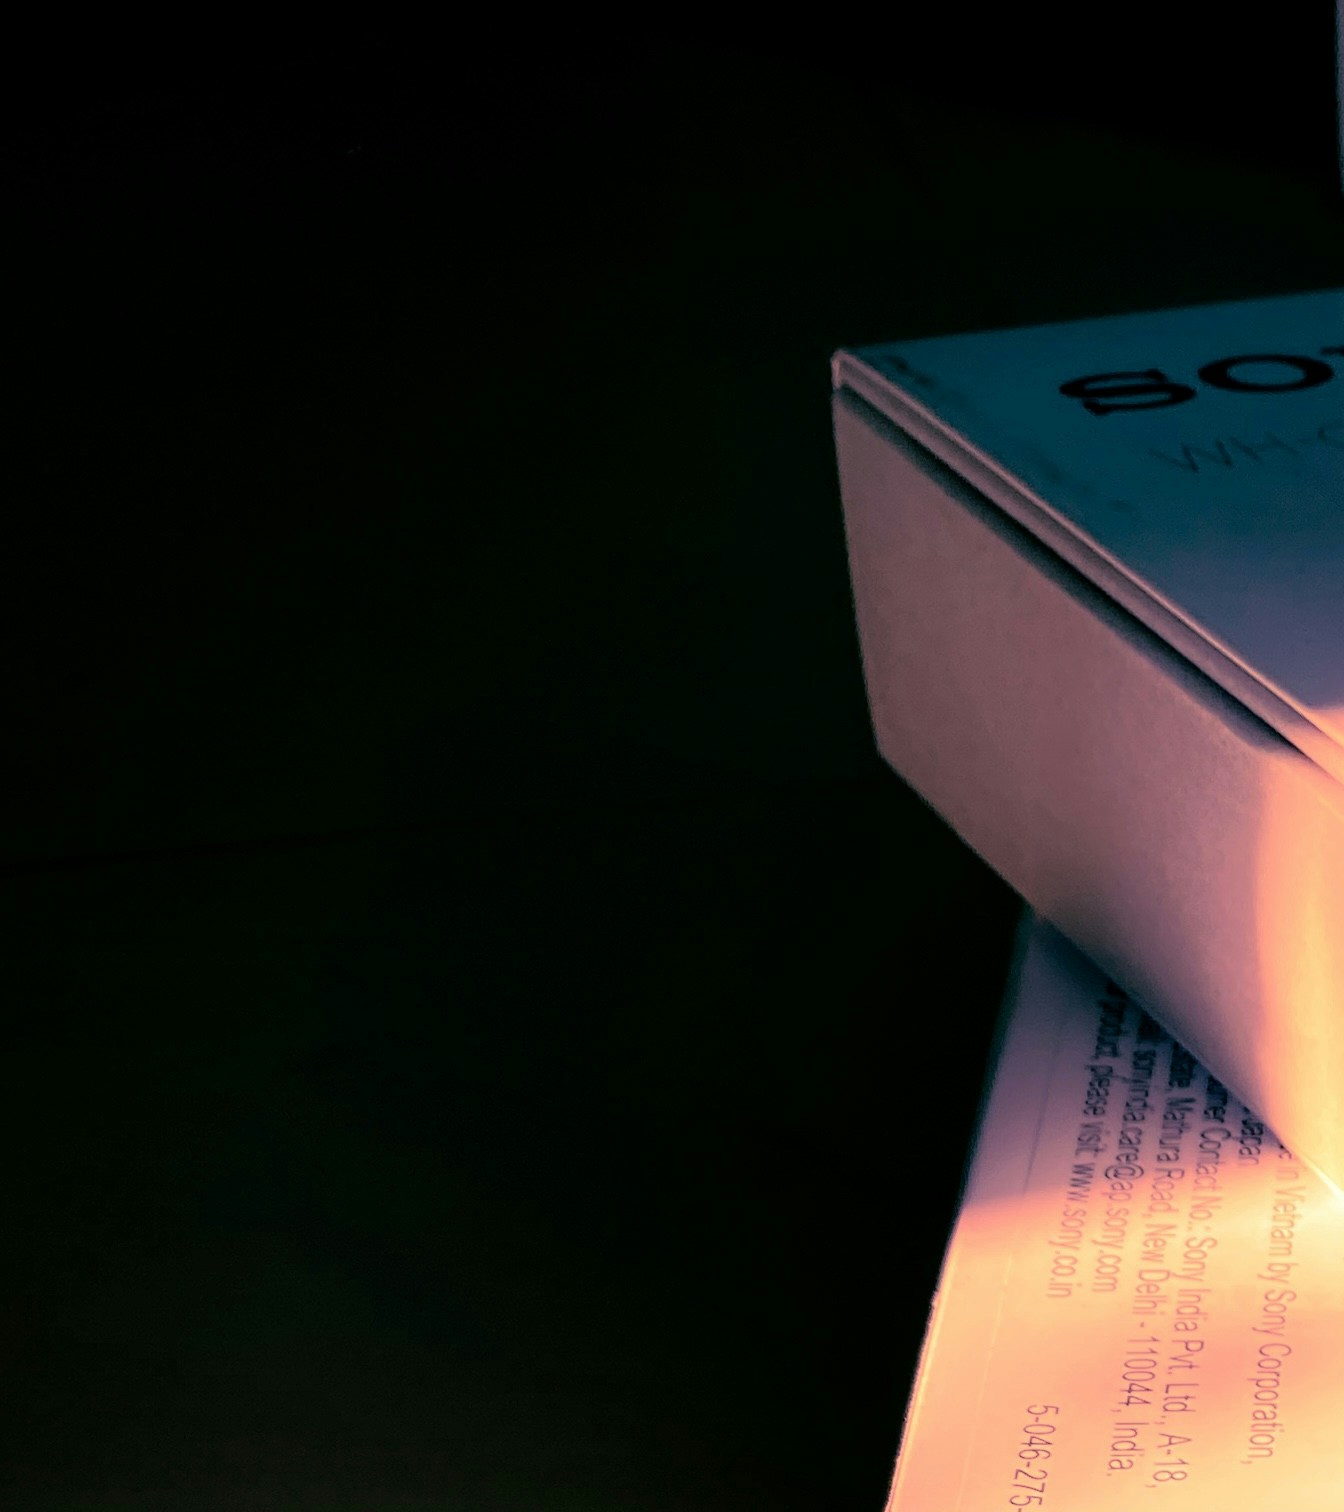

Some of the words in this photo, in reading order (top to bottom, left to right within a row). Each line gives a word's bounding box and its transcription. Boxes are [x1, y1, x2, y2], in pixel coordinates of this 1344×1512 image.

[1085, 1064, 1118, 1116] please
[1158, 1097, 1197, 1161] Mathura
[1092, 1049, 1158, 1292] sonyindia.care@ap.sony.com
[1196, 1128, 1232, 1191] Contact
[1143, 1168, 1185, 1218] Road,
[1046, 1163, 1097, 1298] www.sony.co.in
[1142, 1223, 1178, 1261] New
[1269, 1185, 1305, 1256] Vietnam
[1171, 1237, 1218, 1282] Sony
[1257, 1262, 1299, 1284] by
[1132, 1270, 1171, 1315] Delhi
[1174, 1289, 1214, 1332] India
[1251, 1289, 1297, 1337] Sony
[1111, 1335, 1161, 1413] 110044,
[1167, 1340, 1205, 1375] Pvt.
[1155, 1383, 1199, 1426] Ltd.,
[1240, 1342, 1293, 1465] Corporation,
[1107, 1422, 1151, 1477] India.
[1145, 1433, 1193, 1488] A-18,
